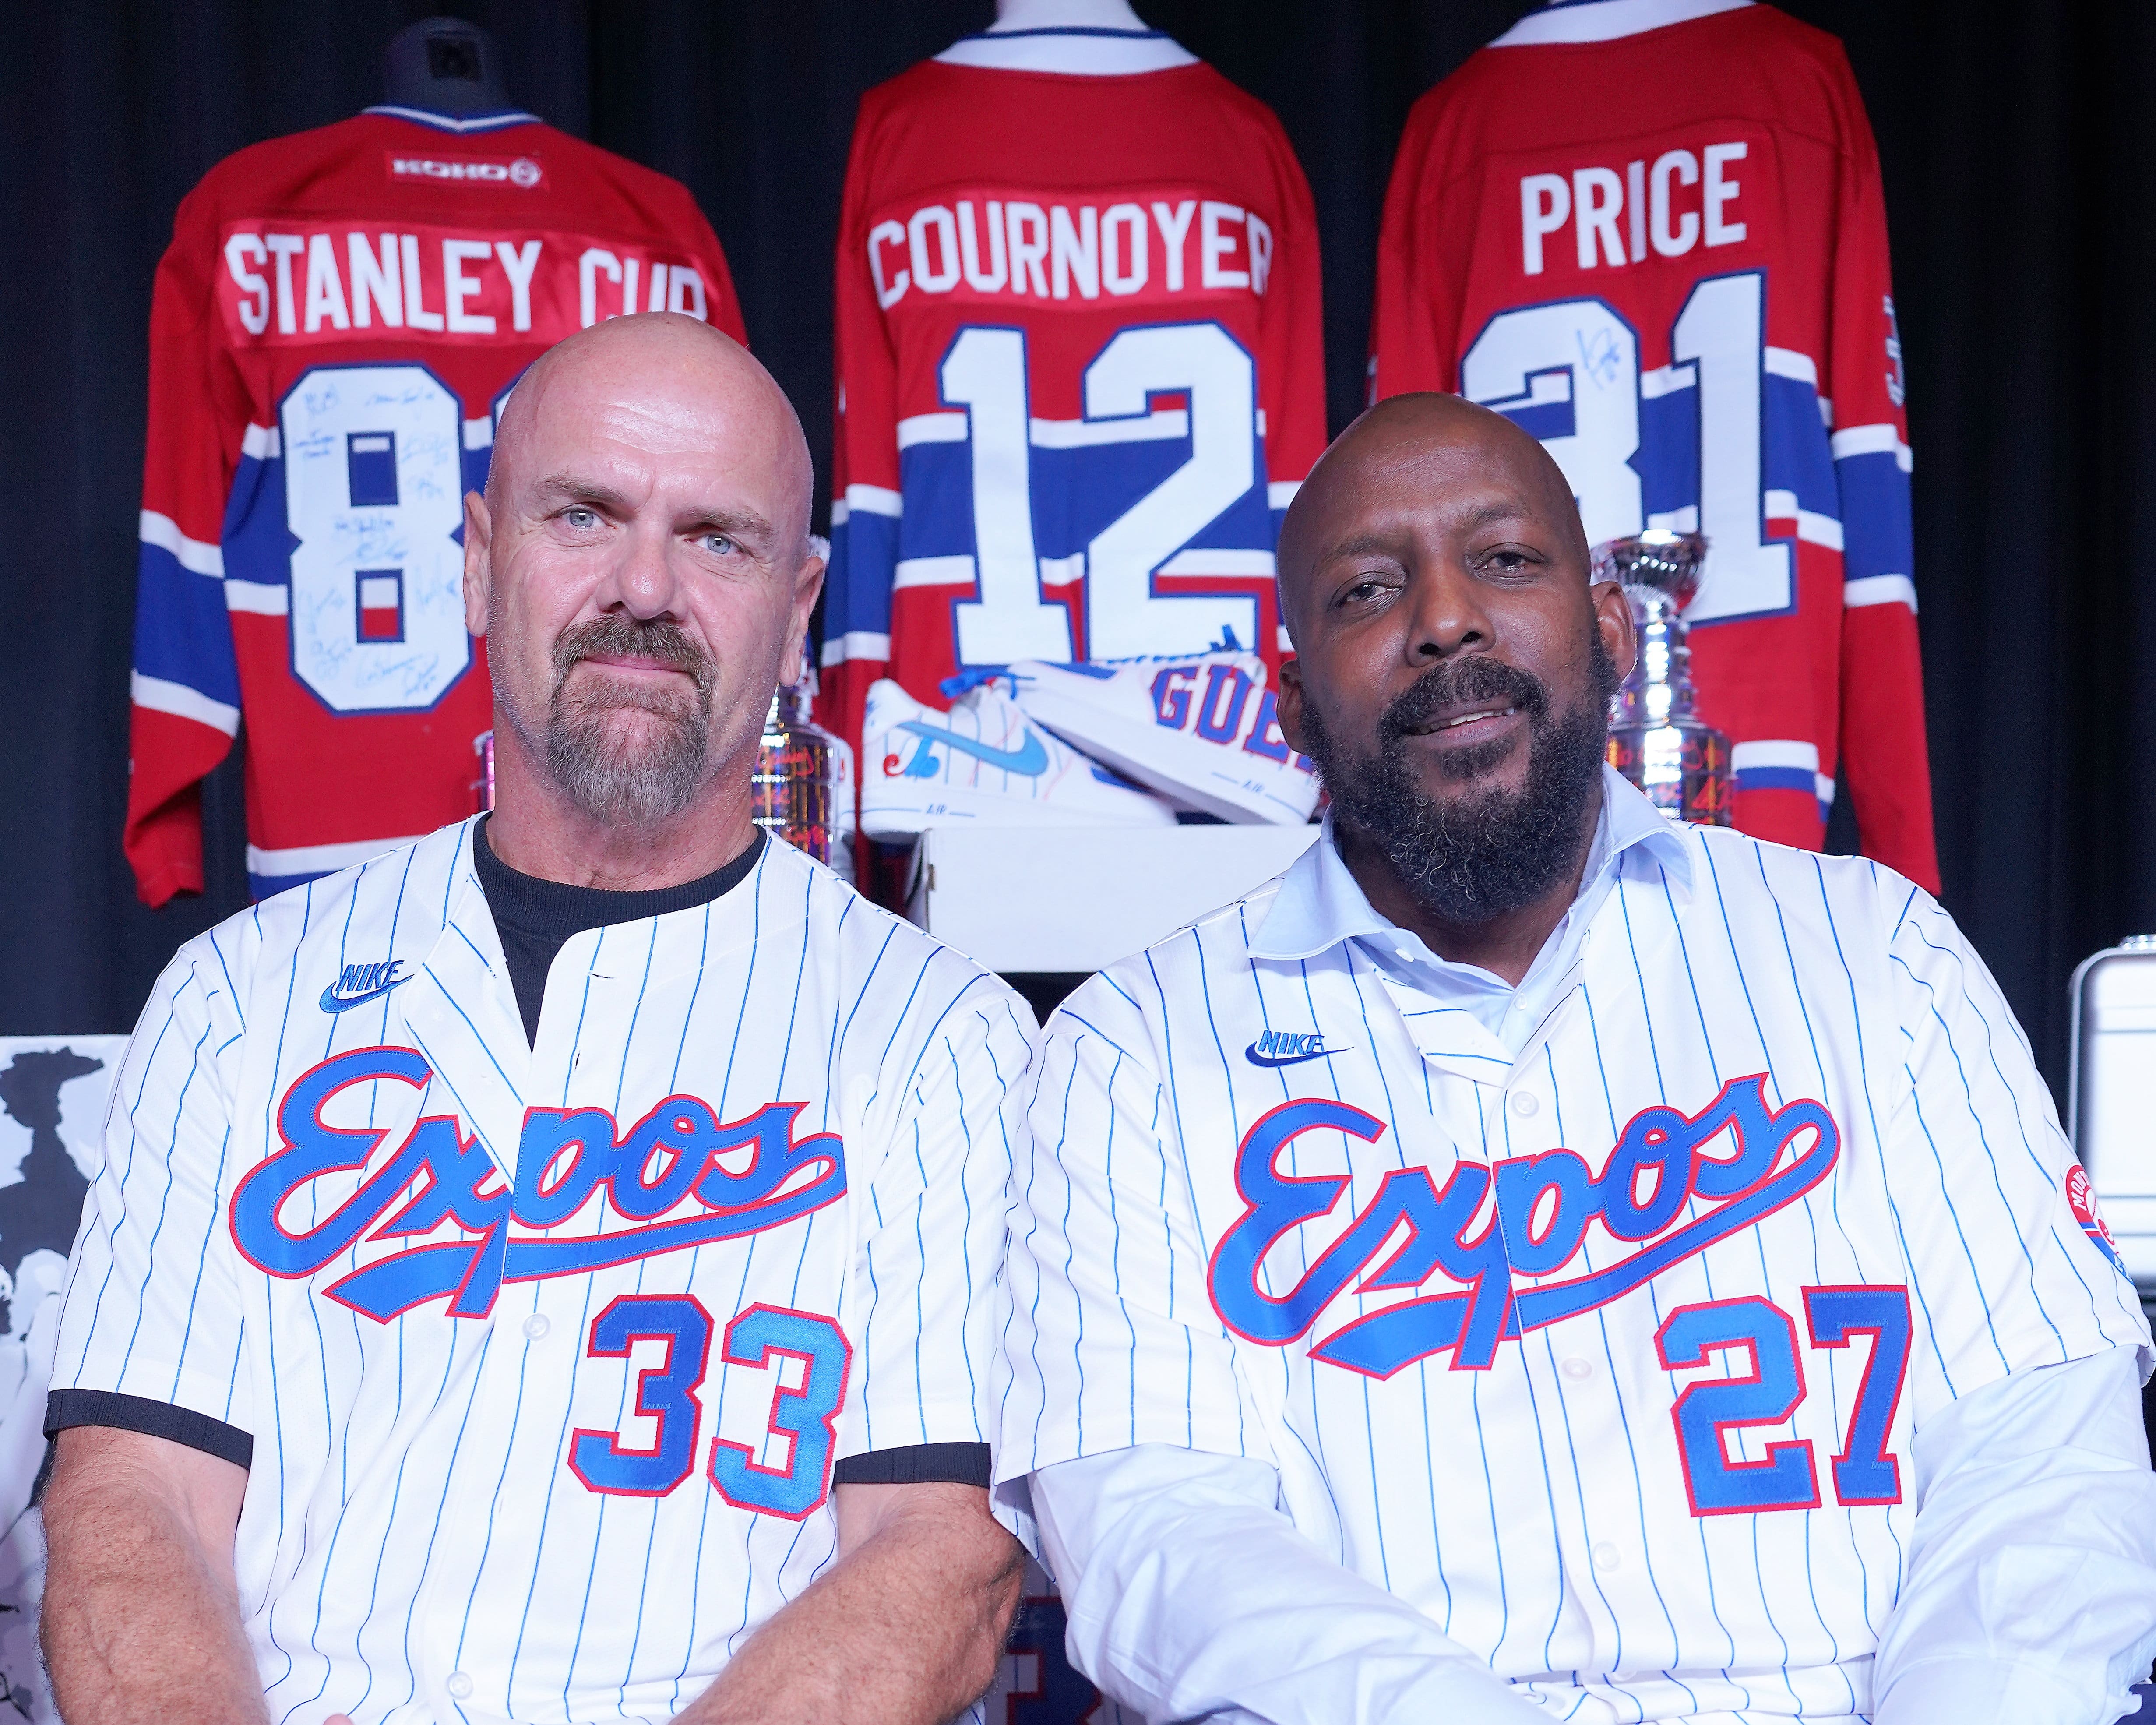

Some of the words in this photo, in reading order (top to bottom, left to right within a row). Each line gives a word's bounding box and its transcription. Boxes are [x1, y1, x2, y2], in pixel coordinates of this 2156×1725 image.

[224, 231, 543, 335] STANLEY
[579, 247, 708, 329] CUP
[867, 200, 1274, 310] COURNOYER
[1519, 141, 1748, 275] PRICE
[276, 360, 535, 718] 8
[937, 318, 1260, 667] 12
[1460, 266, 1799, 625] 31
[1149, 663, 1314, 776] GUE
[335, 960, 405, 992] NIKE
[1257, 1030, 1325, 1055] NIKE
[229, 1045, 848, 1325] Expos
[1207, 1072, 1842, 1382] Expos
[567, 1293, 854, 1522] 33
[1653, 1285, 1913, 1518] 27
